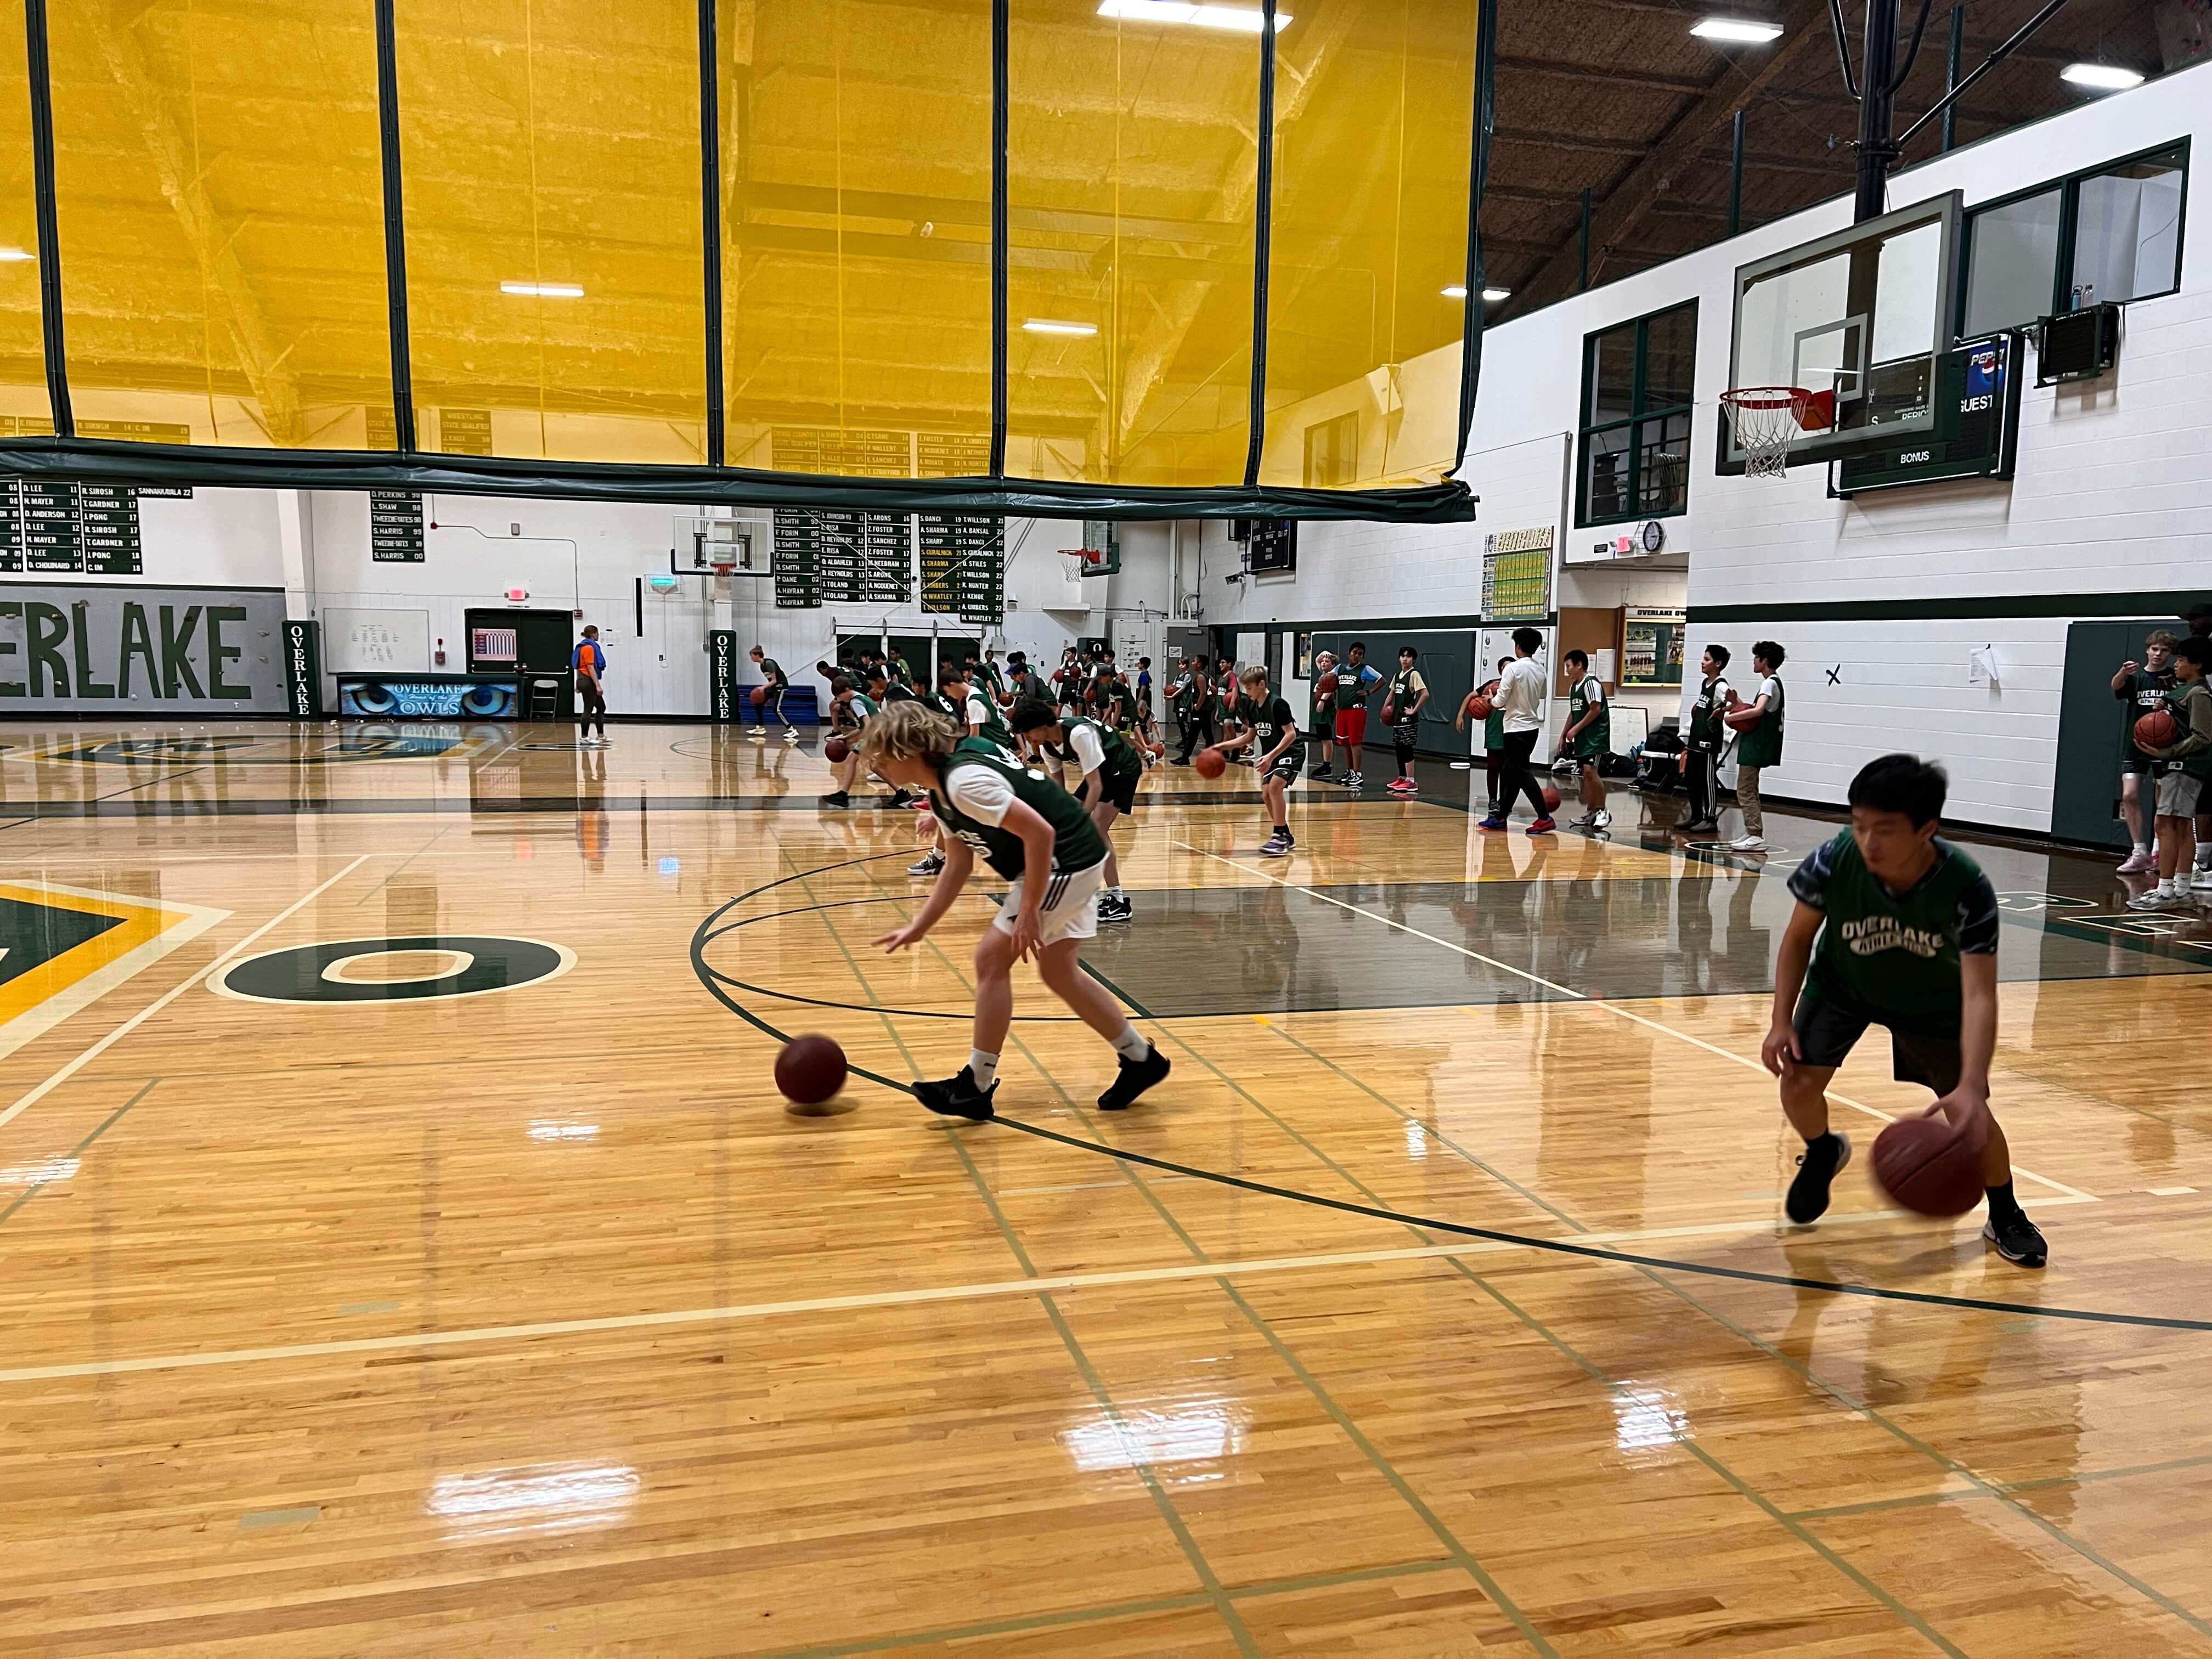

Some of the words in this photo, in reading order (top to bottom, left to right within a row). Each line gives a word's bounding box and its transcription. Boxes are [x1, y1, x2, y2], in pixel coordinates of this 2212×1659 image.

[1900, 451, 1929, 464] BONUS
[291, 626, 309, 715] OVERLAKE
[717, 635, 729, 718] OVERLAKE
[394, 684, 462, 694] OVERLAKE
[400, 702, 460, 714] OWLS
[939, 696, 953, 712] 6
